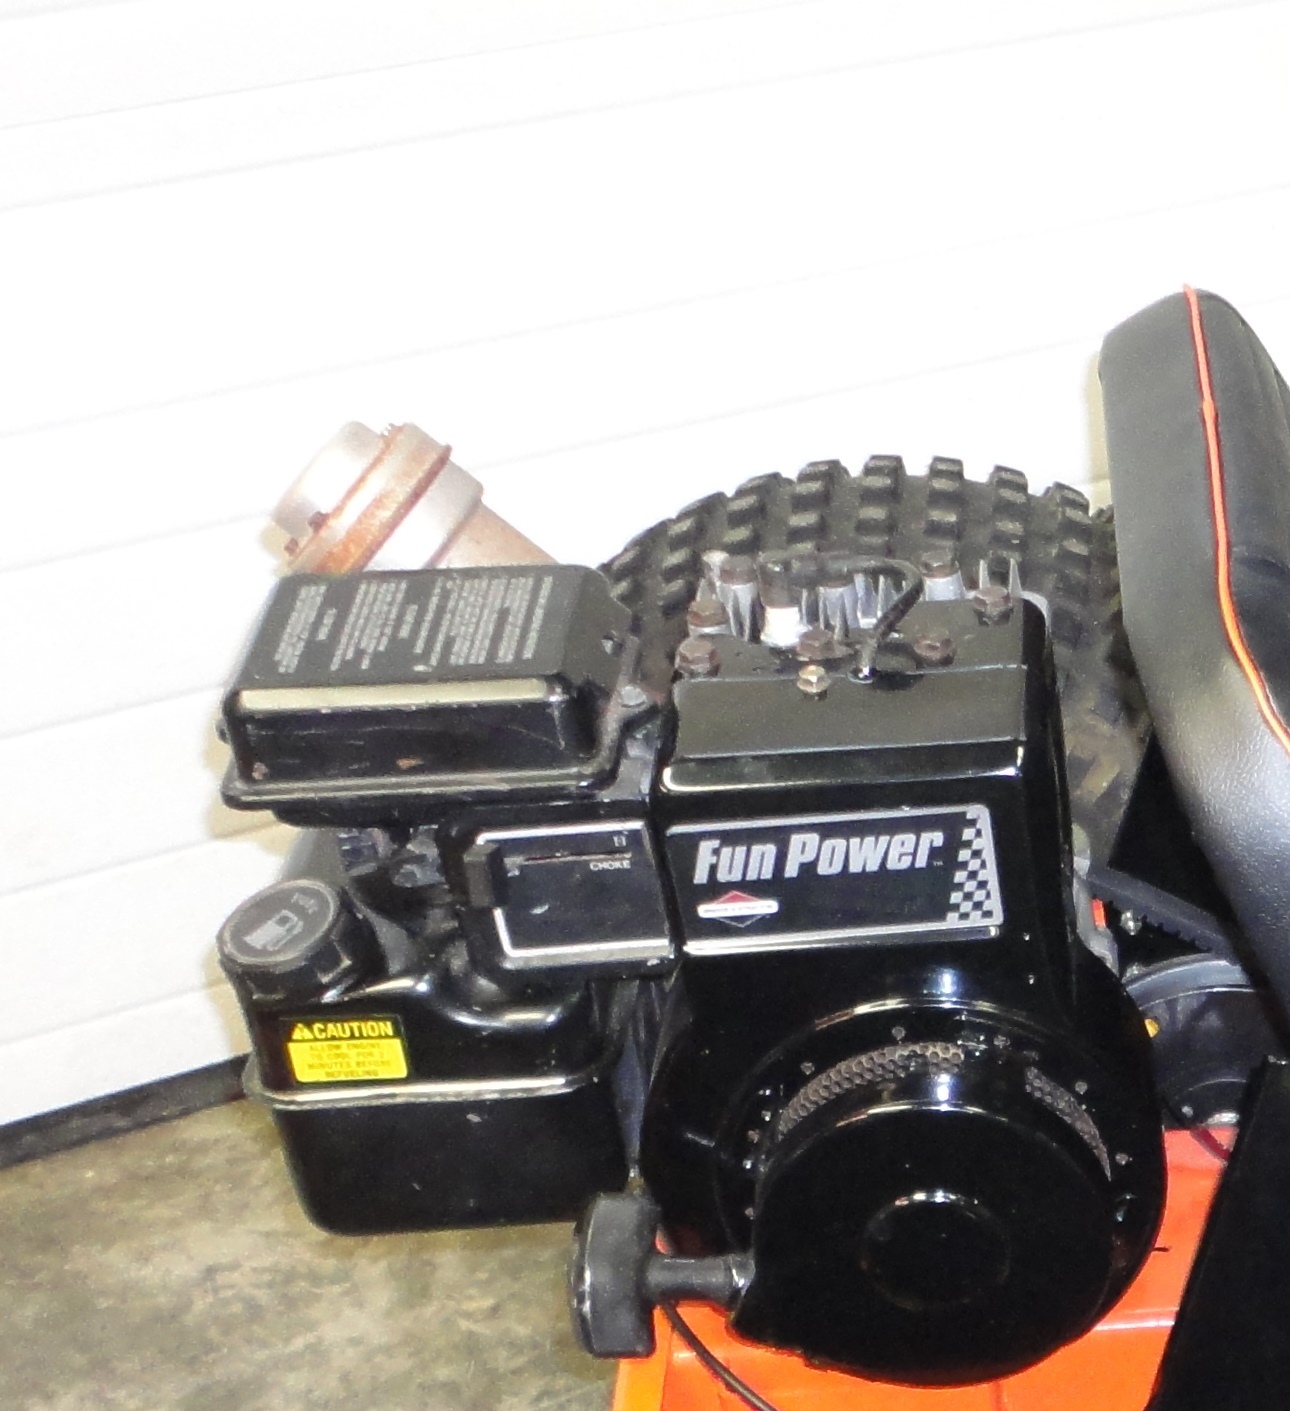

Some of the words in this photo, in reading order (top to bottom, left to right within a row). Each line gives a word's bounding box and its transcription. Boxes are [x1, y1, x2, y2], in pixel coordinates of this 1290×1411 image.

[589, 860, 631, 871] CHOKE
[693, 839, 777, 884] Fun
[784, 831, 944, 879] Power
[312, 1021, 394, 1039] CAUTION
